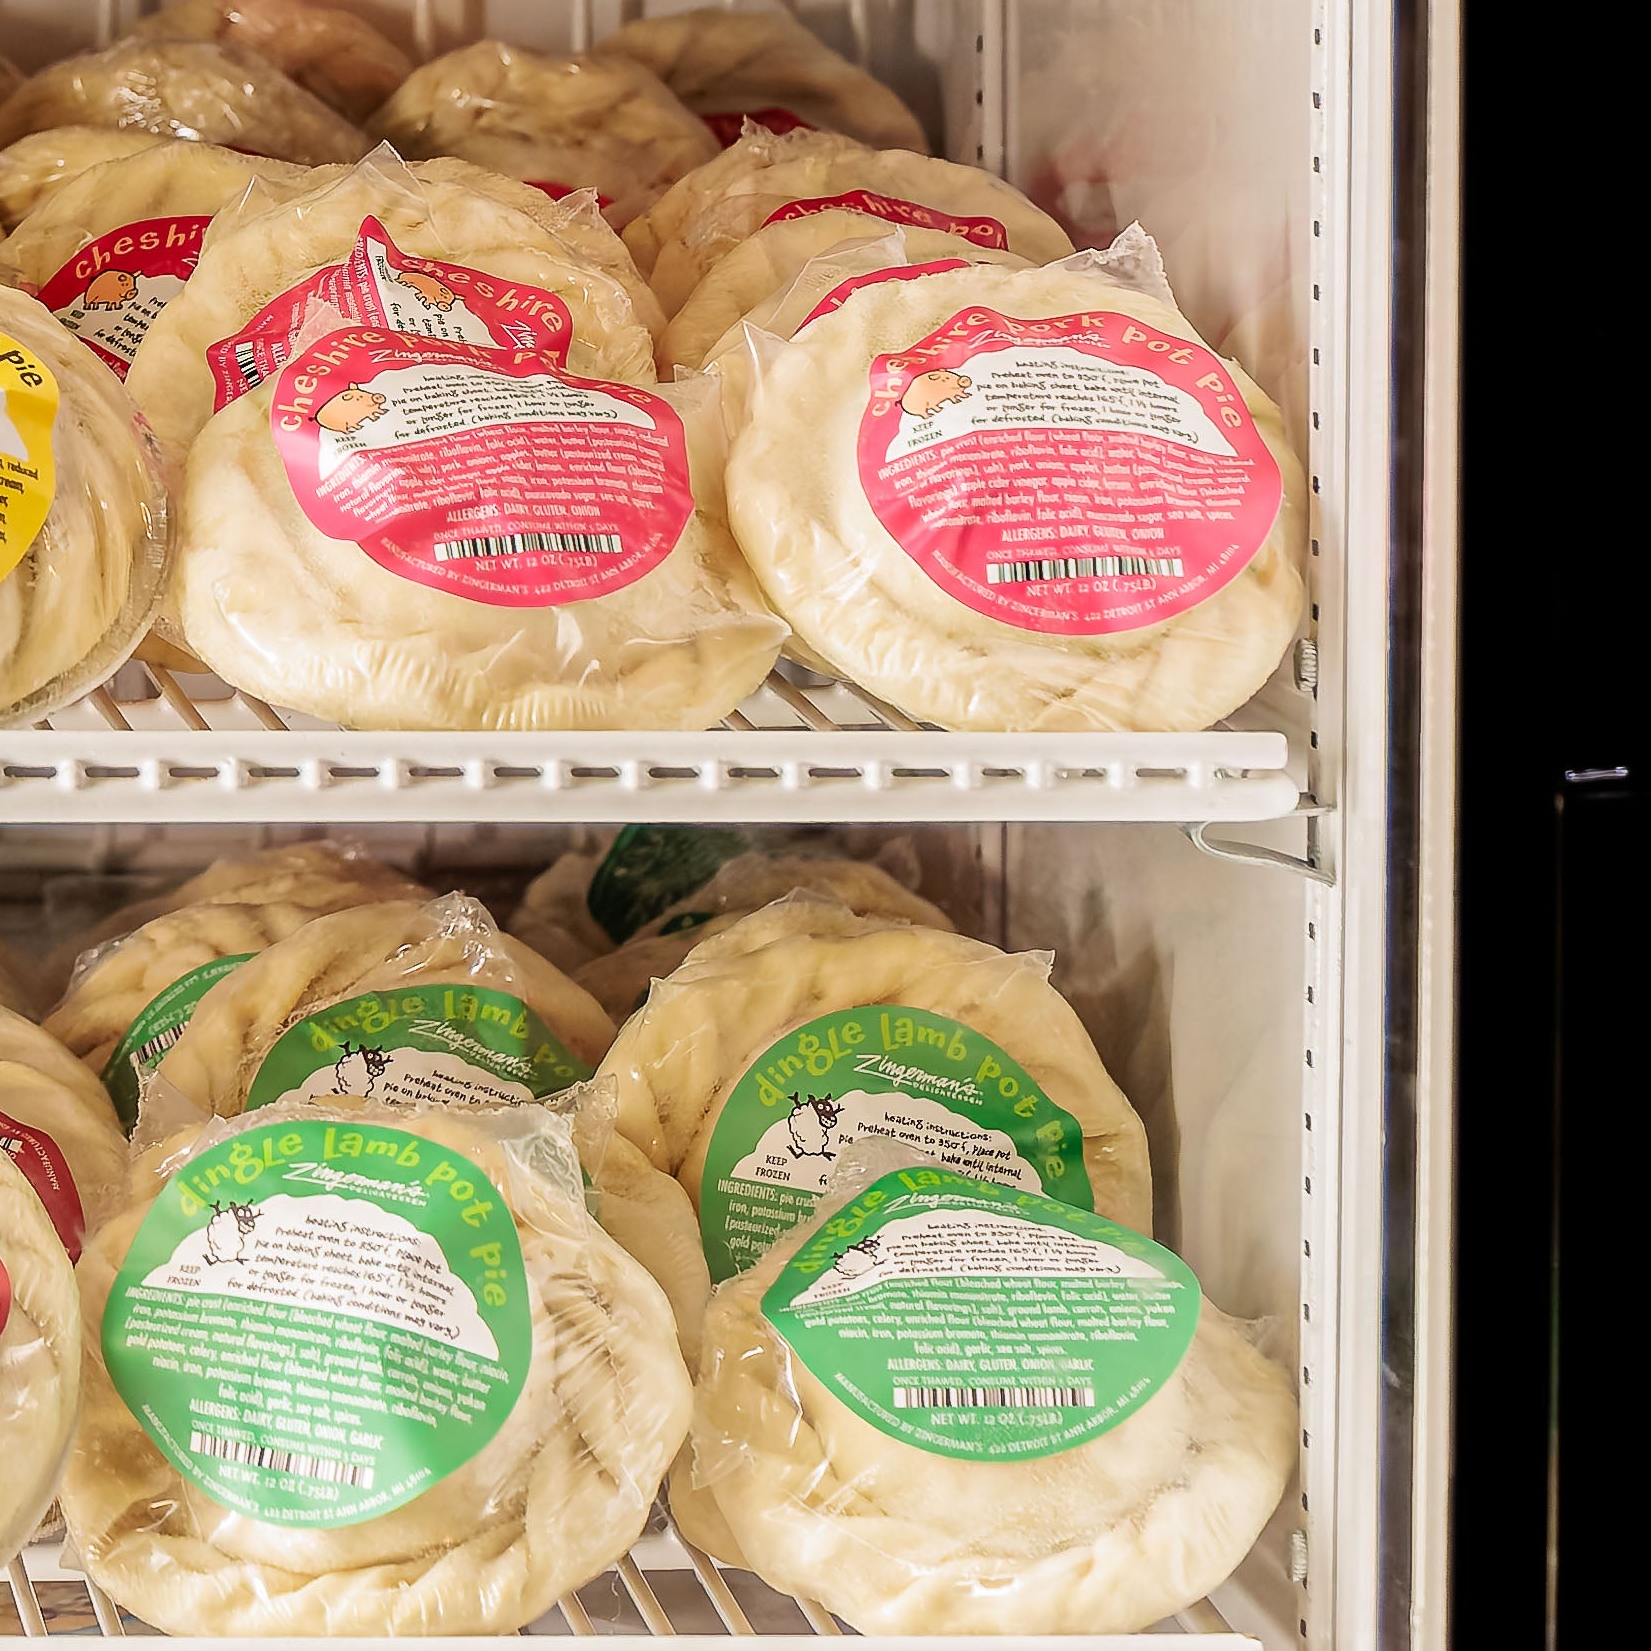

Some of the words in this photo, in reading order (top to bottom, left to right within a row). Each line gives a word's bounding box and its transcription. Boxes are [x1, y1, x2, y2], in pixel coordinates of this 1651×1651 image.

[278, 329, 387, 433] cheshire
[1121, 326, 1195, 366] pot
[1195, 371, 1244, 429] pie
[764, 1155, 789, 1168] KEEP
[976, 1053, 1041, 1119] pot
[1035, 1120, 1068, 1182] pie
[755, 1166, 792, 1182] FROZEN
[425, 1161, 490, 1228] pot
[470, 1241, 508, 1308] pie
